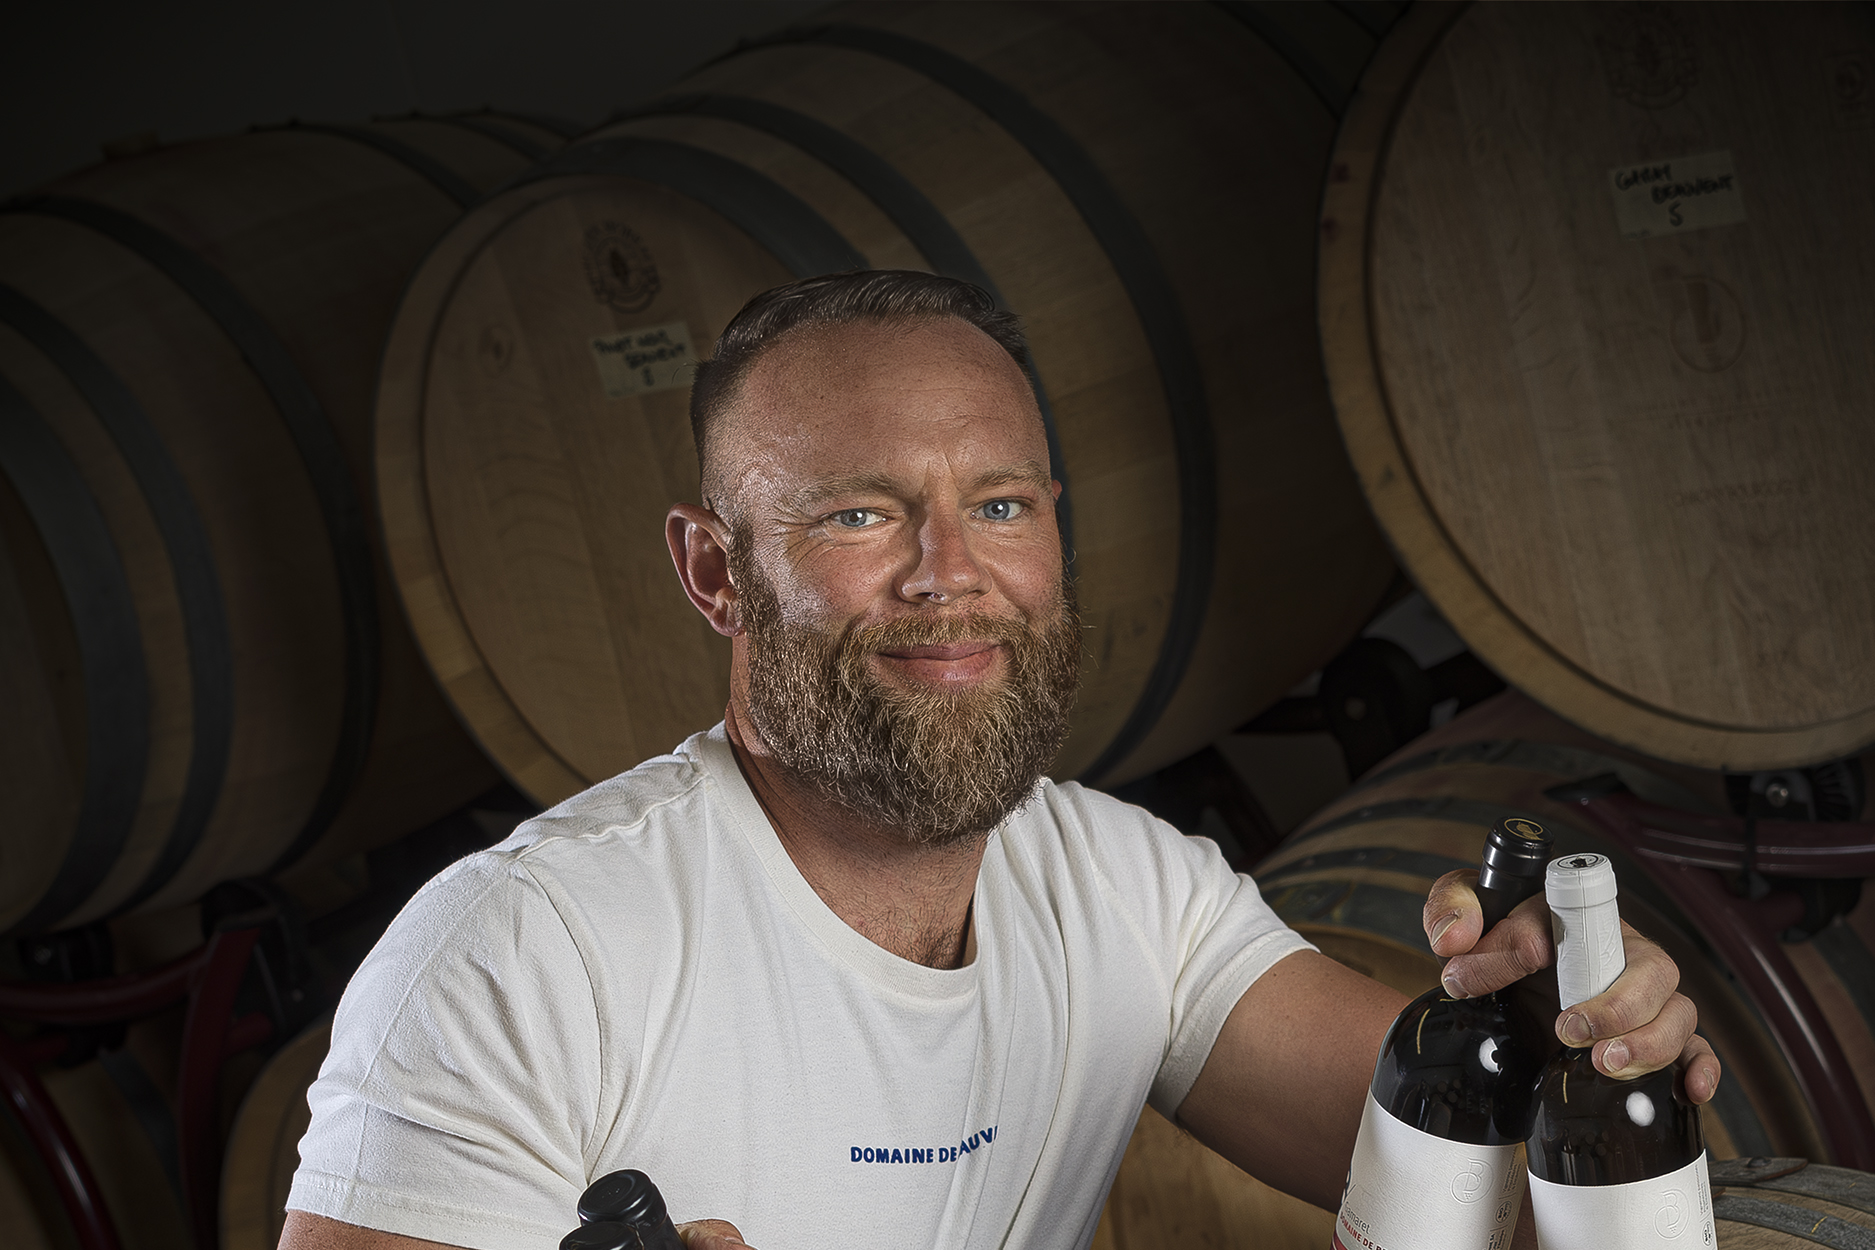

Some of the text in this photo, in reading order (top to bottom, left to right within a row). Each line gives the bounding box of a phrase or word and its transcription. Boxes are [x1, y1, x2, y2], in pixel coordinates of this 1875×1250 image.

[850, 1146, 934, 1164] DOMAINE
[938, 1147, 957, 1163] DE
[1363, 1238, 1373, 1250] DE
